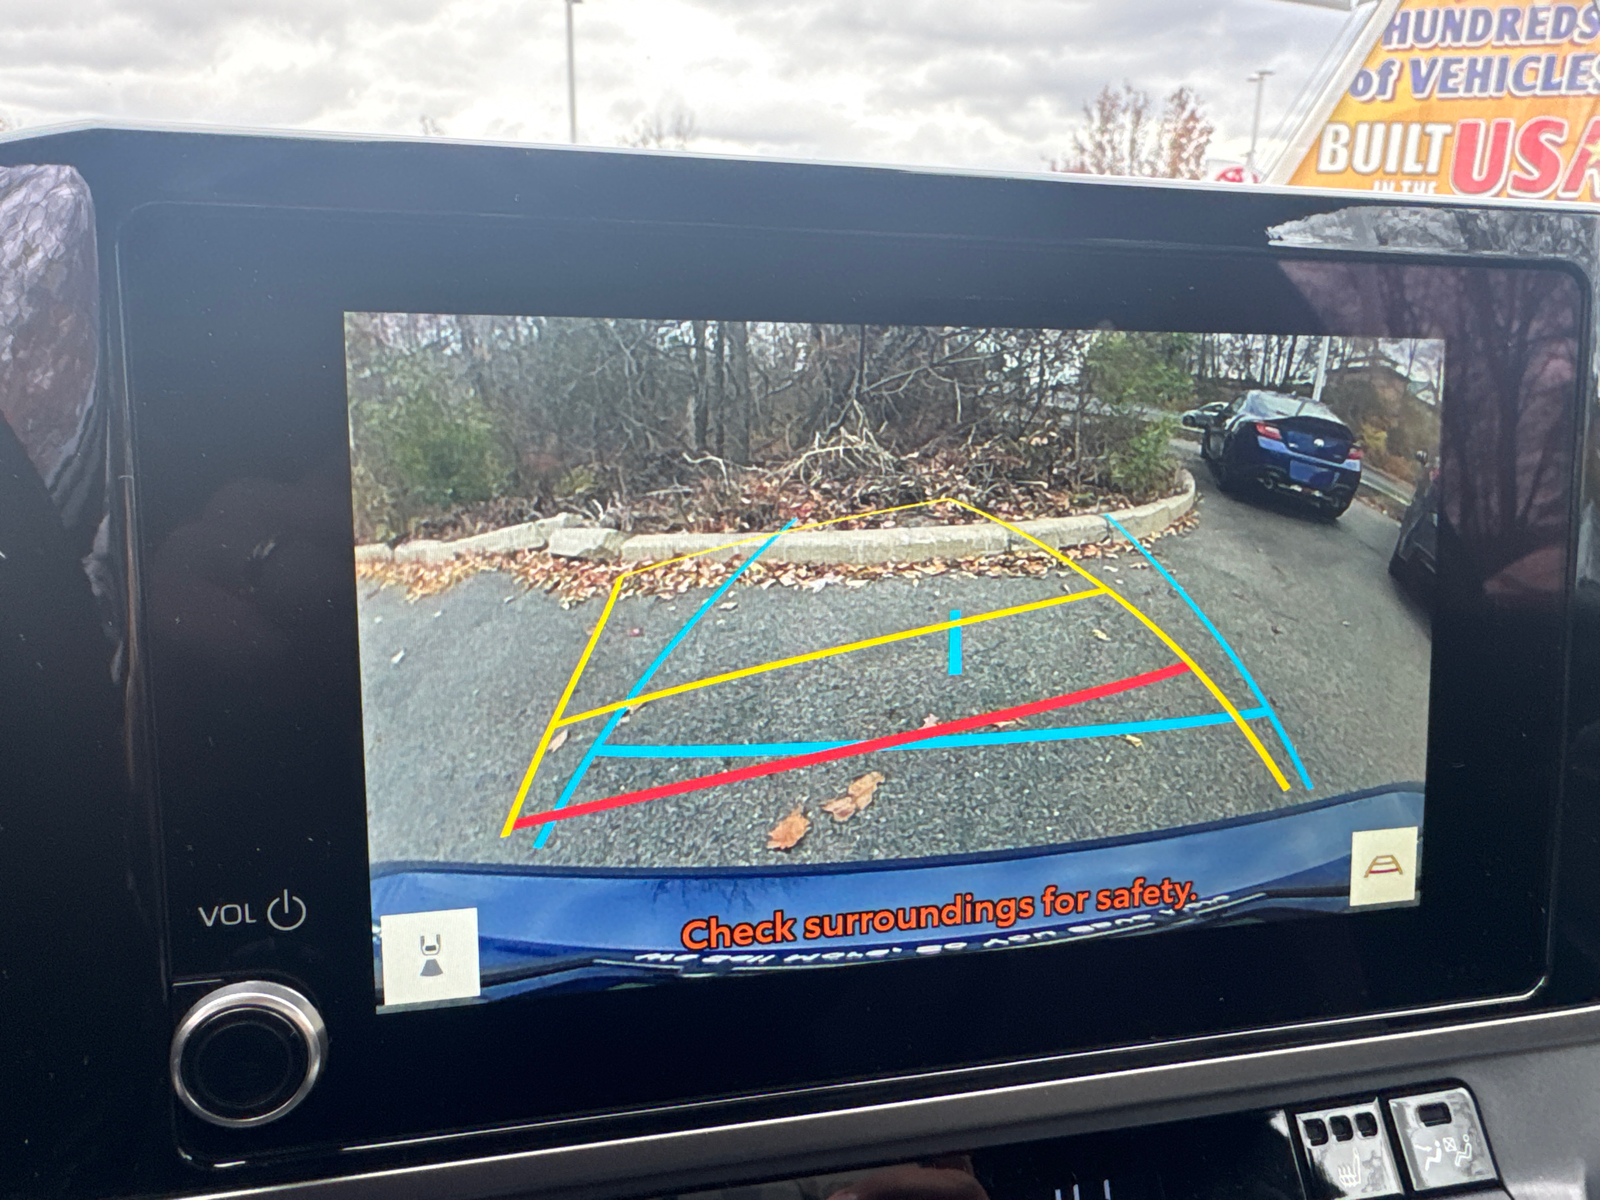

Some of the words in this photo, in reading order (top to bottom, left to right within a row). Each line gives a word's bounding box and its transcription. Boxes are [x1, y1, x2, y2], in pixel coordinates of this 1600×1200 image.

[1350, 59, 1400, 101] of
[1317, 121, 1453, 175] BUILT
[198, 903, 257, 927] VOL
[680, 909, 797, 951] Check
[803, 894, 1035, 940] surroundings
[1041, 884, 1091, 918] for
[1095, 876, 1197, 912] safety.
